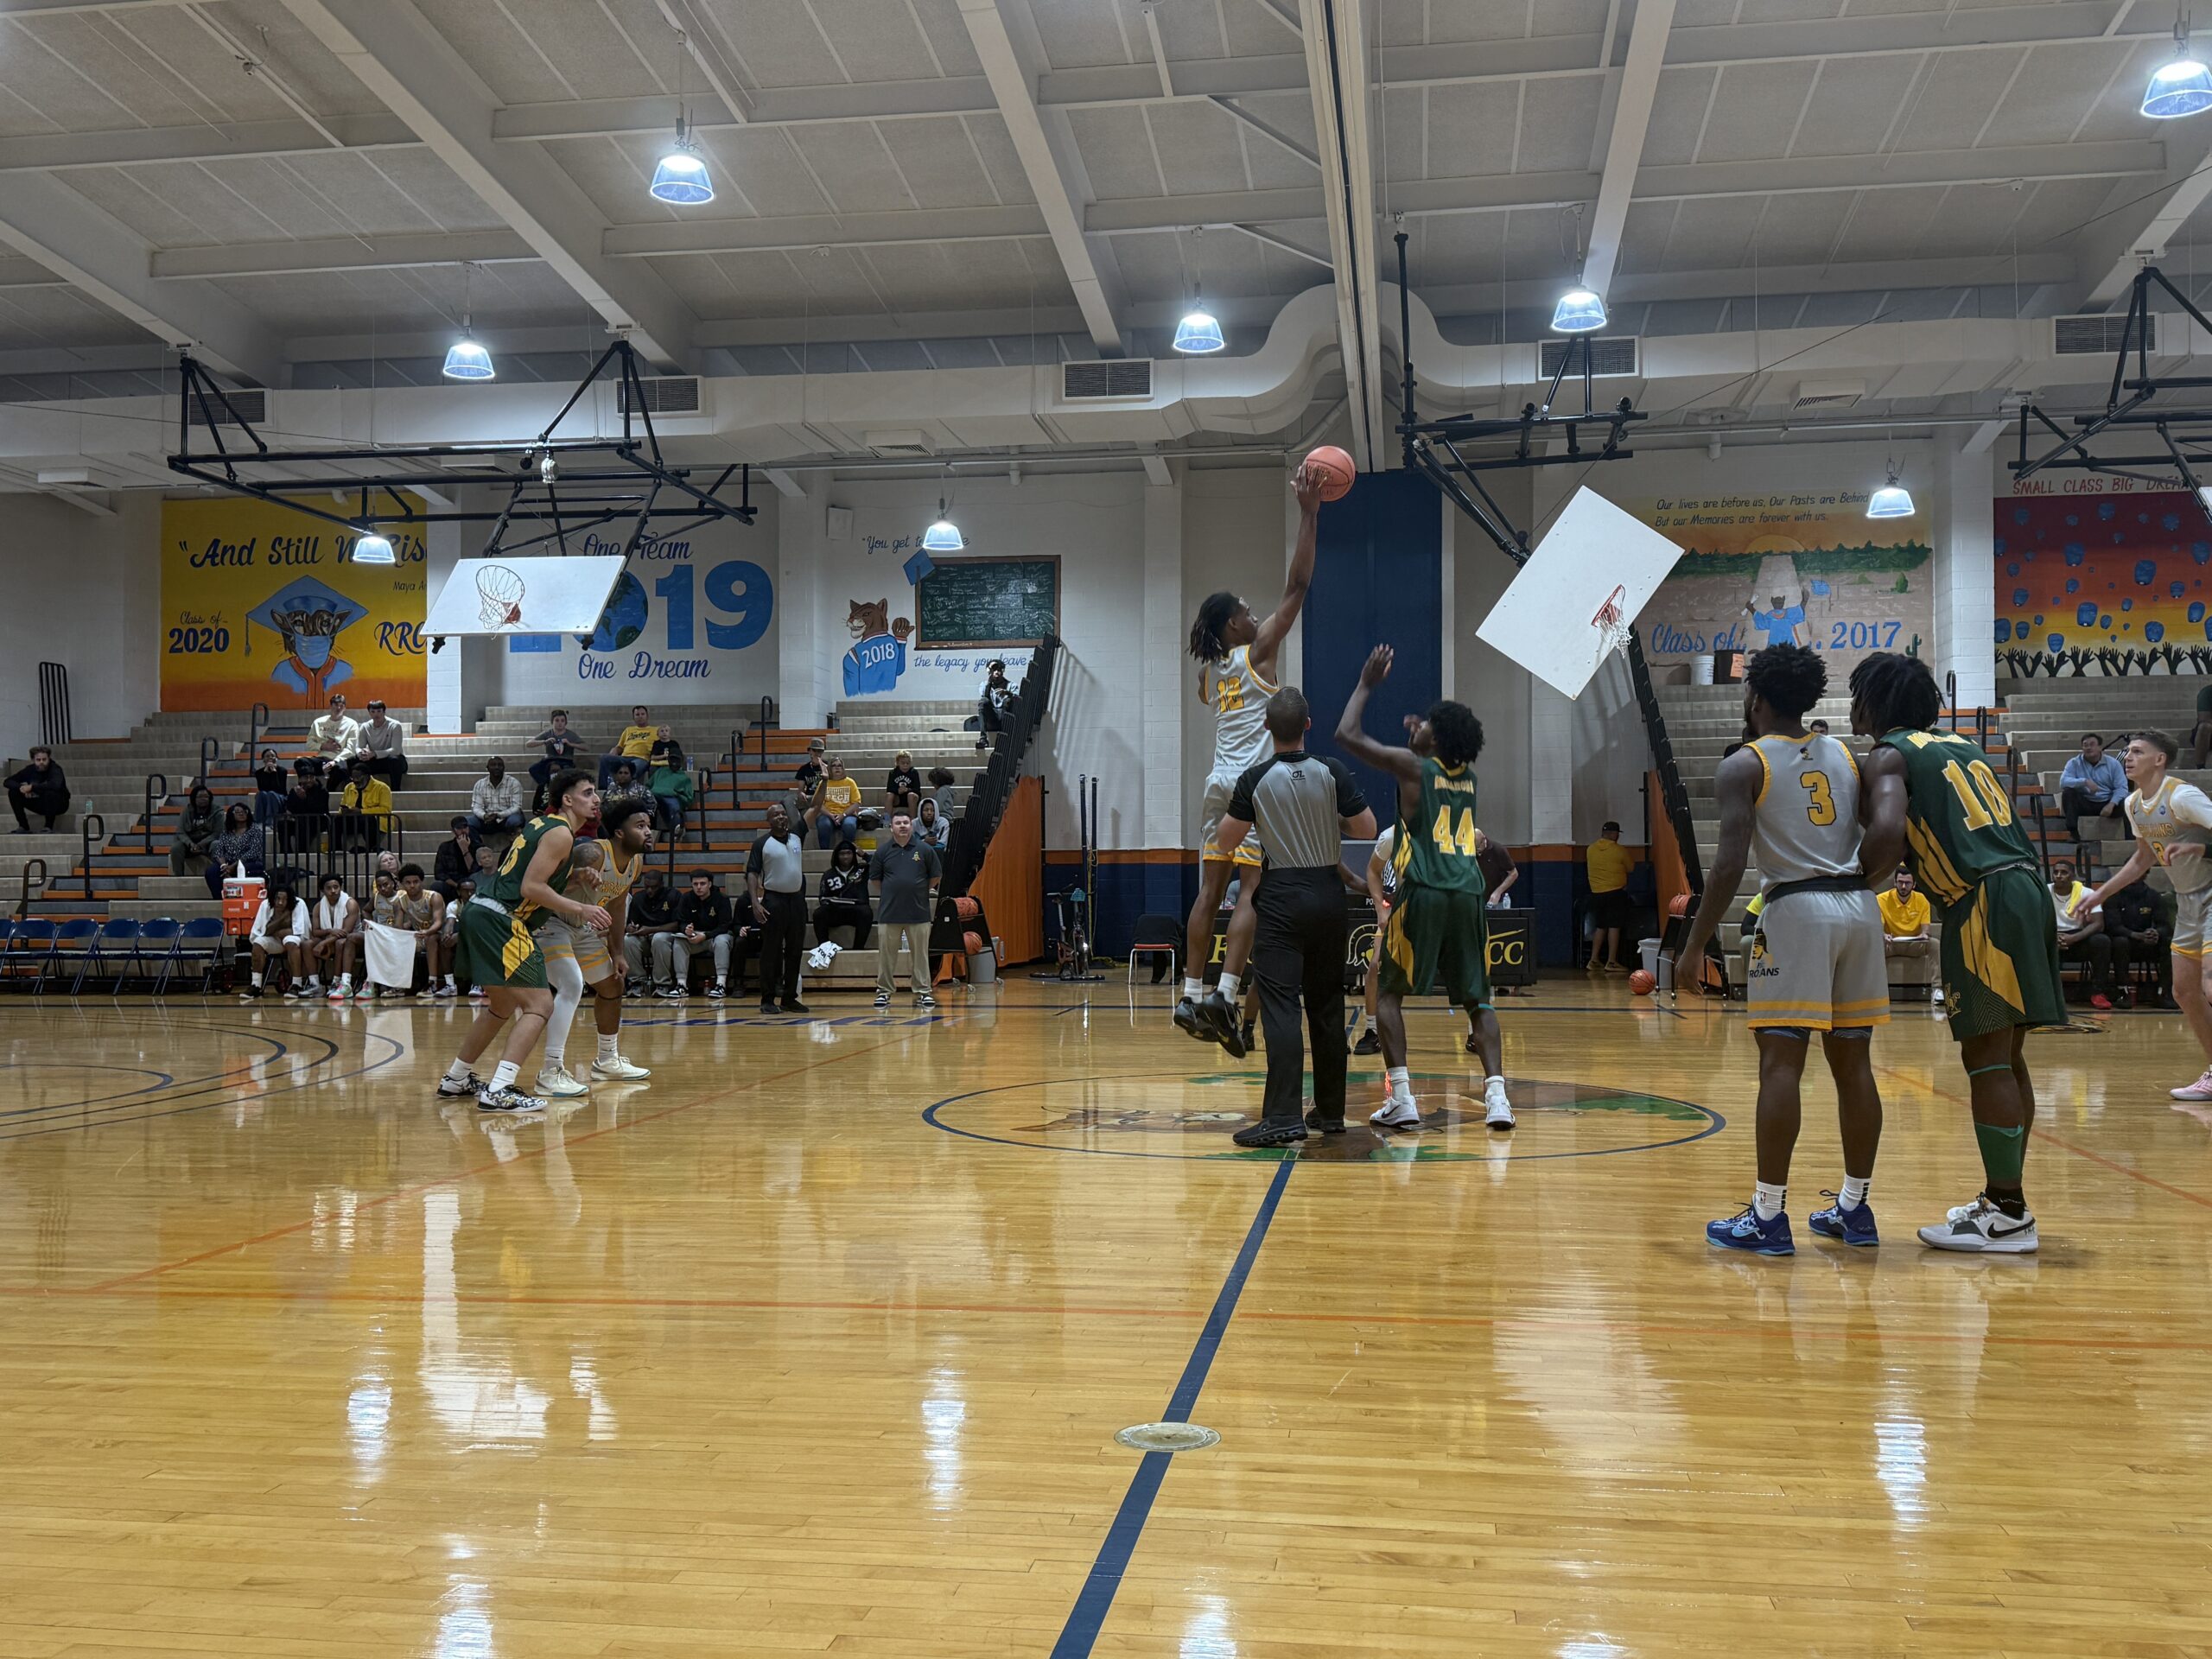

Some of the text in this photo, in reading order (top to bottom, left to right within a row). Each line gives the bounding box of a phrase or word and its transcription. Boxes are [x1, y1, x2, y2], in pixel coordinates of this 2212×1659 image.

[2012, 480, 2055, 495] SMALL
[2063, 478, 2103, 493] CLASS
[2112, 477, 2134, 492] BIG
[1656, 499, 1673, 510] Our
[1678, 498, 1699, 510] lives
[1702, 499, 1719, 509] are
[1721, 495, 1751, 508] before
[1770, 496, 1785, 506] Our
[1789, 494, 1816, 505] Pasts
[1820, 495, 1836, 505] are
[1655, 515, 1669, 527] But
[1673, 518, 1688, 526] our
[1690, 513, 1735, 525] Memories
[1738, 515, 1756, 524] are
[1759, 512, 1791, 524] forever
[1794, 510, 1813, 522] with
[268, 536, 325, 566] Still
[583, 531, 694, 560] One Team
[892, 534, 910, 554] get
[392, 581, 416, 594] Maya
[180, 609, 206, 625] Class
[168, 627, 231, 654] 2020
[1651, 621, 1707, 653] Class
[1829, 621, 1903, 650] 2017
[578, 651, 712, 679] One Dream
[861, 642, 895, 669] 2018
[913, 655, 931, 667] the
[934, 654, 969, 672] legacy
[1217, 676, 1245, 713] 12
[1800, 771, 1837, 826] 3
[1942, 760, 2012, 831] 10
[1432, 804, 1477, 857] 44
